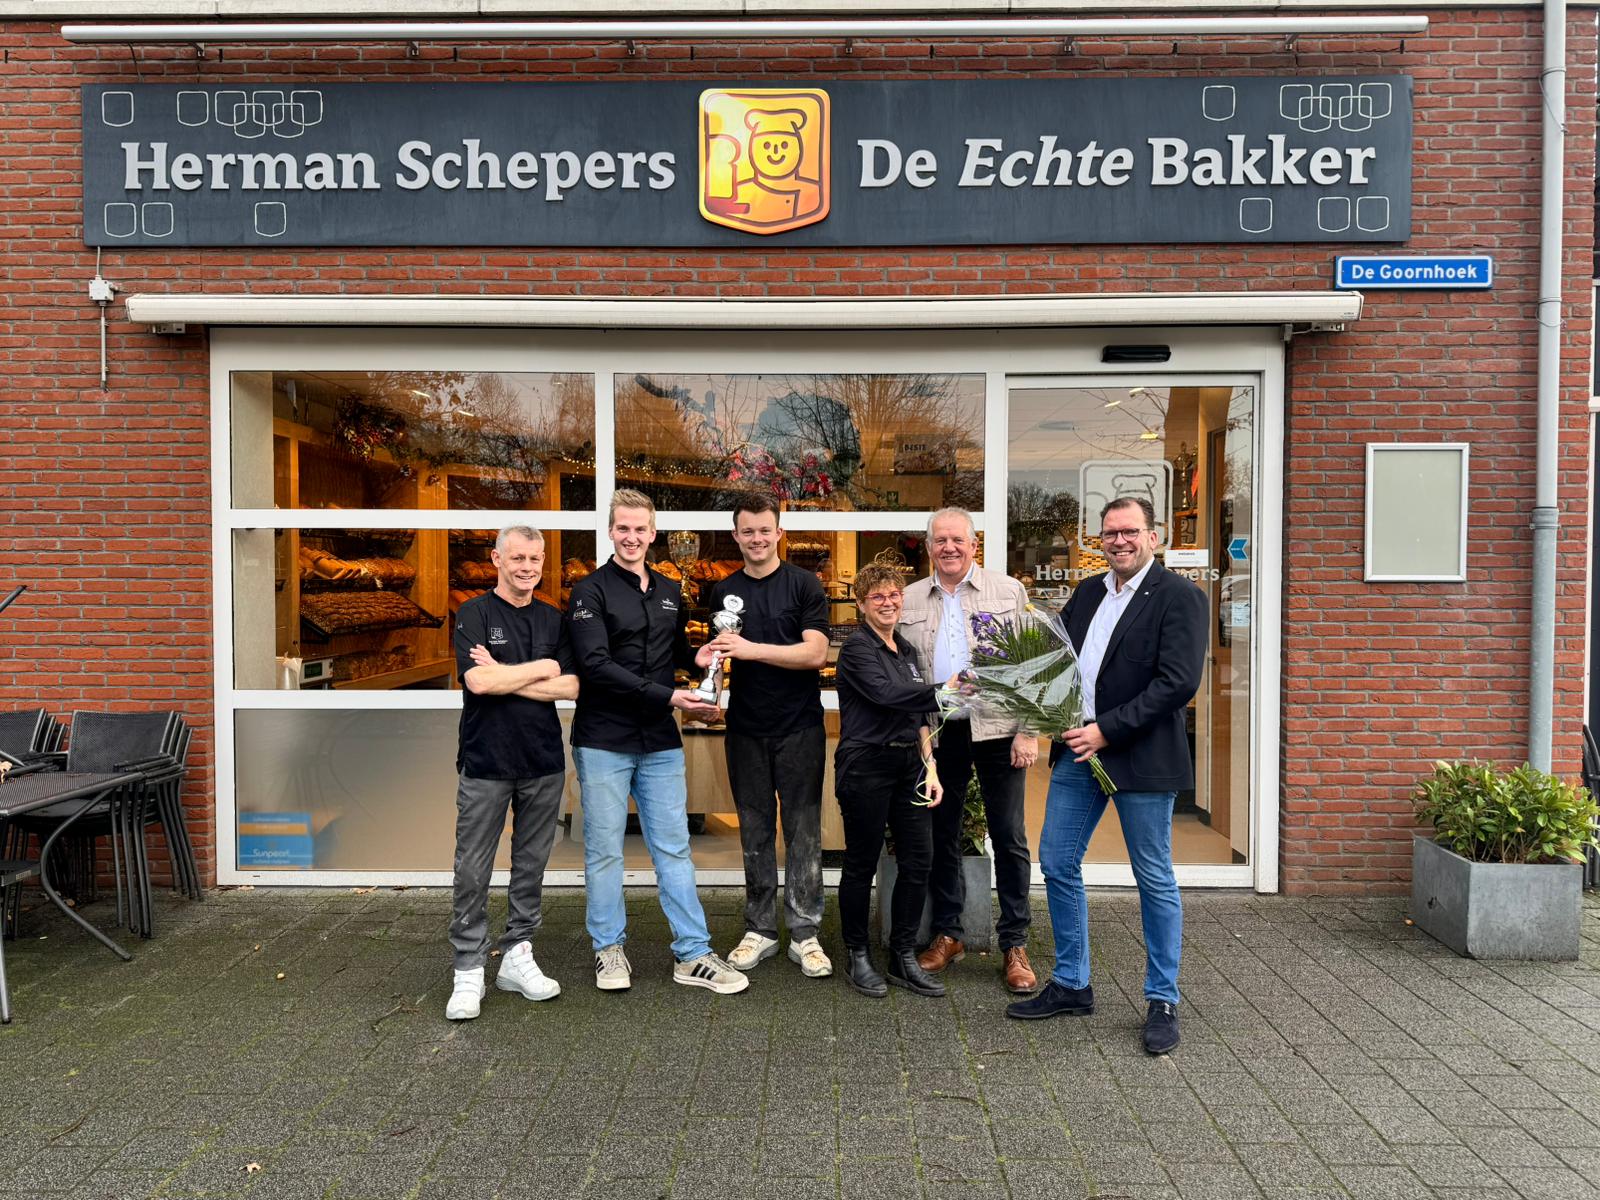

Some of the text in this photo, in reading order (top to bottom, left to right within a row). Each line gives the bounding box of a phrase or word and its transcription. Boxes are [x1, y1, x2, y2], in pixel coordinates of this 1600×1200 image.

[121, 138, 676, 201] Herman Schepers
[858, 133, 1377, 189] De Echte Bakker
[1352, 264, 1477, 279] De Goornhoek
